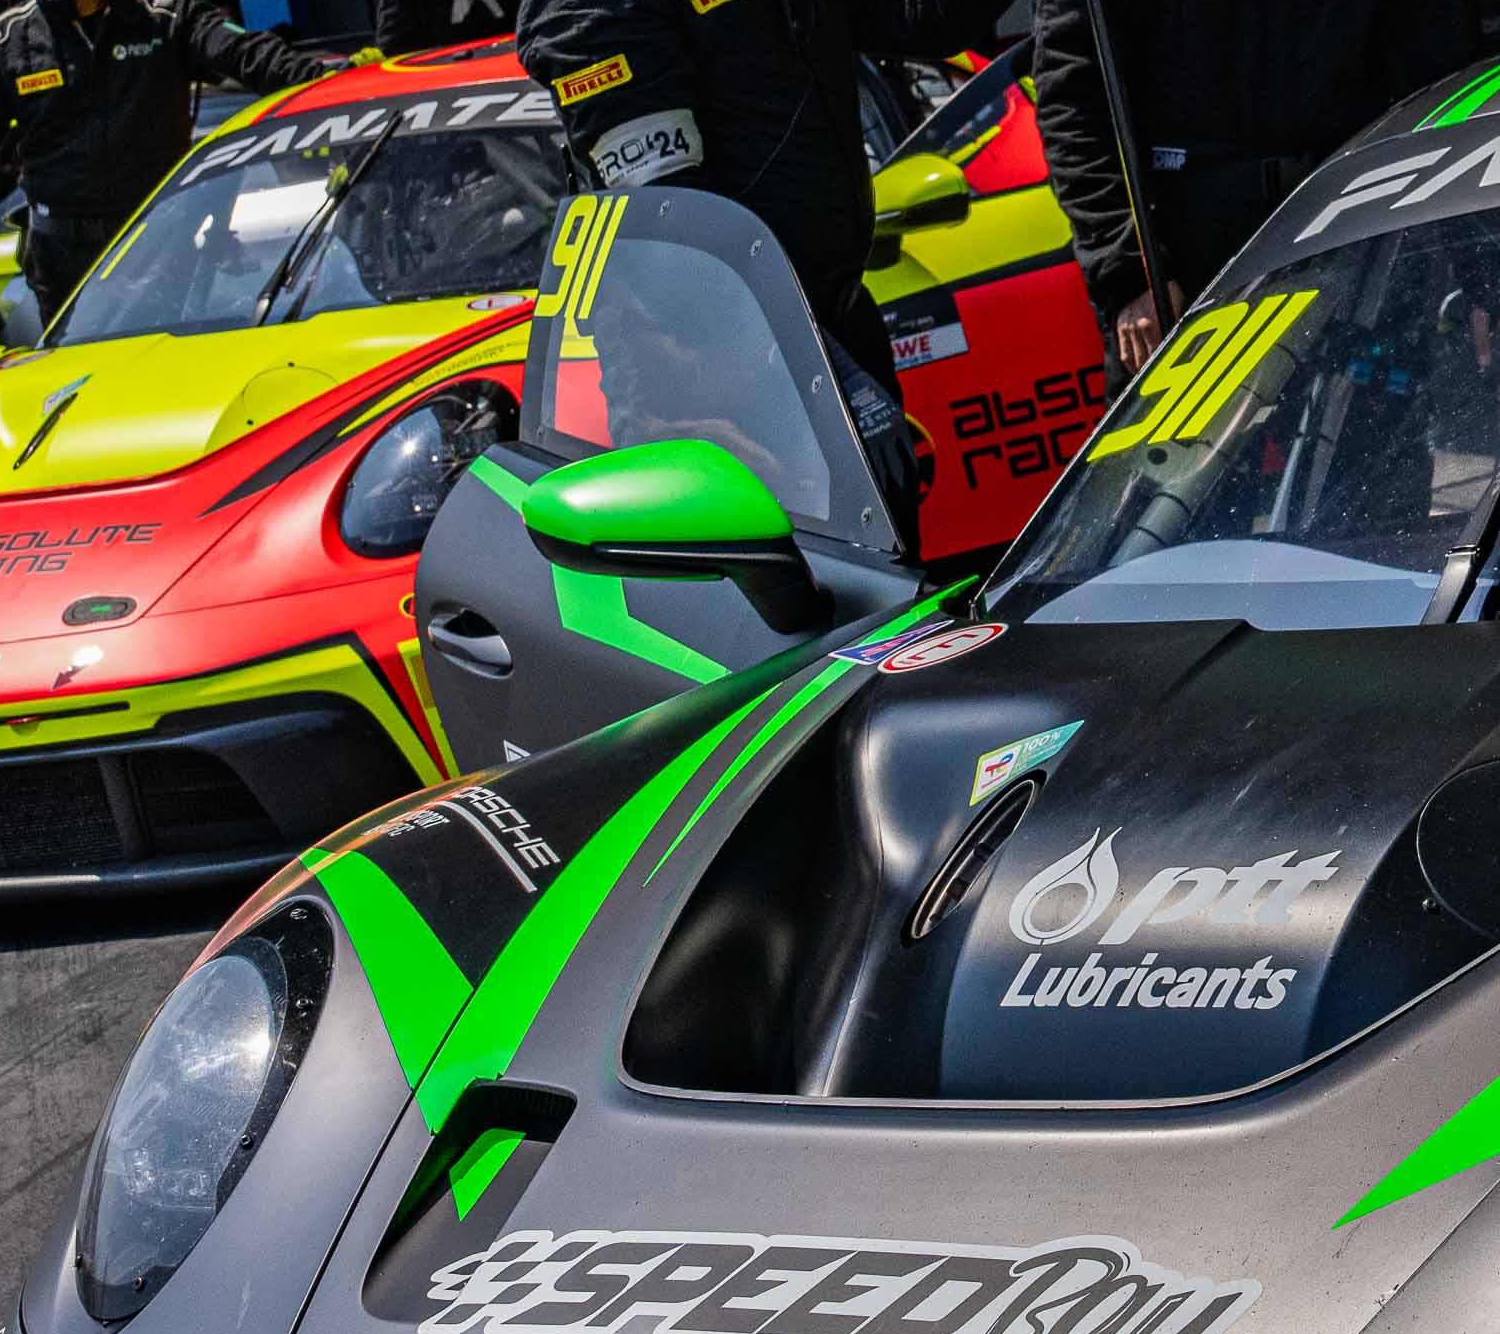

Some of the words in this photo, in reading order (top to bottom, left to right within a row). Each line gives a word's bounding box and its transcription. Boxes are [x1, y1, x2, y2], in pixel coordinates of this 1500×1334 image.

[563, 63, 625, 102] PIRELLI
[179, 90, 556, 188] FANATE
[533, 194, 631, 320] 911
[1087, 290, 1320, 463] 911
[1097, 849, 1343, 945] ptt
[999, 952, 1298, 1010] Lubricants
